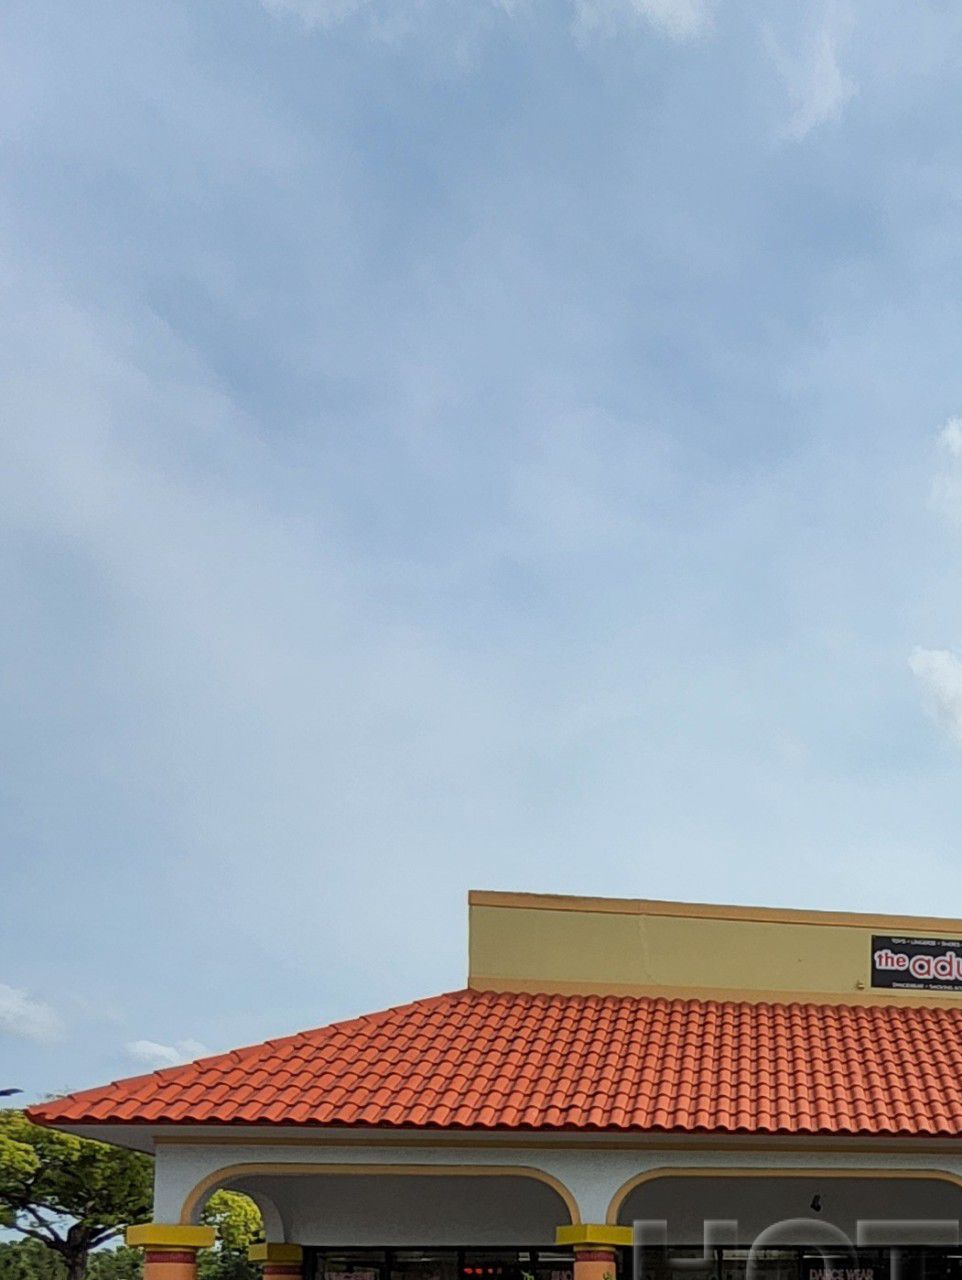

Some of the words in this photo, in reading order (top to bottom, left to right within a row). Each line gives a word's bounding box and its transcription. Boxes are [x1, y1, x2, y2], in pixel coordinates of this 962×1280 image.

[874, 949, 909, 970] the
[809, 1268, 844, 1280] DANCE
[846, 1268, 874, 1280] WEAR
